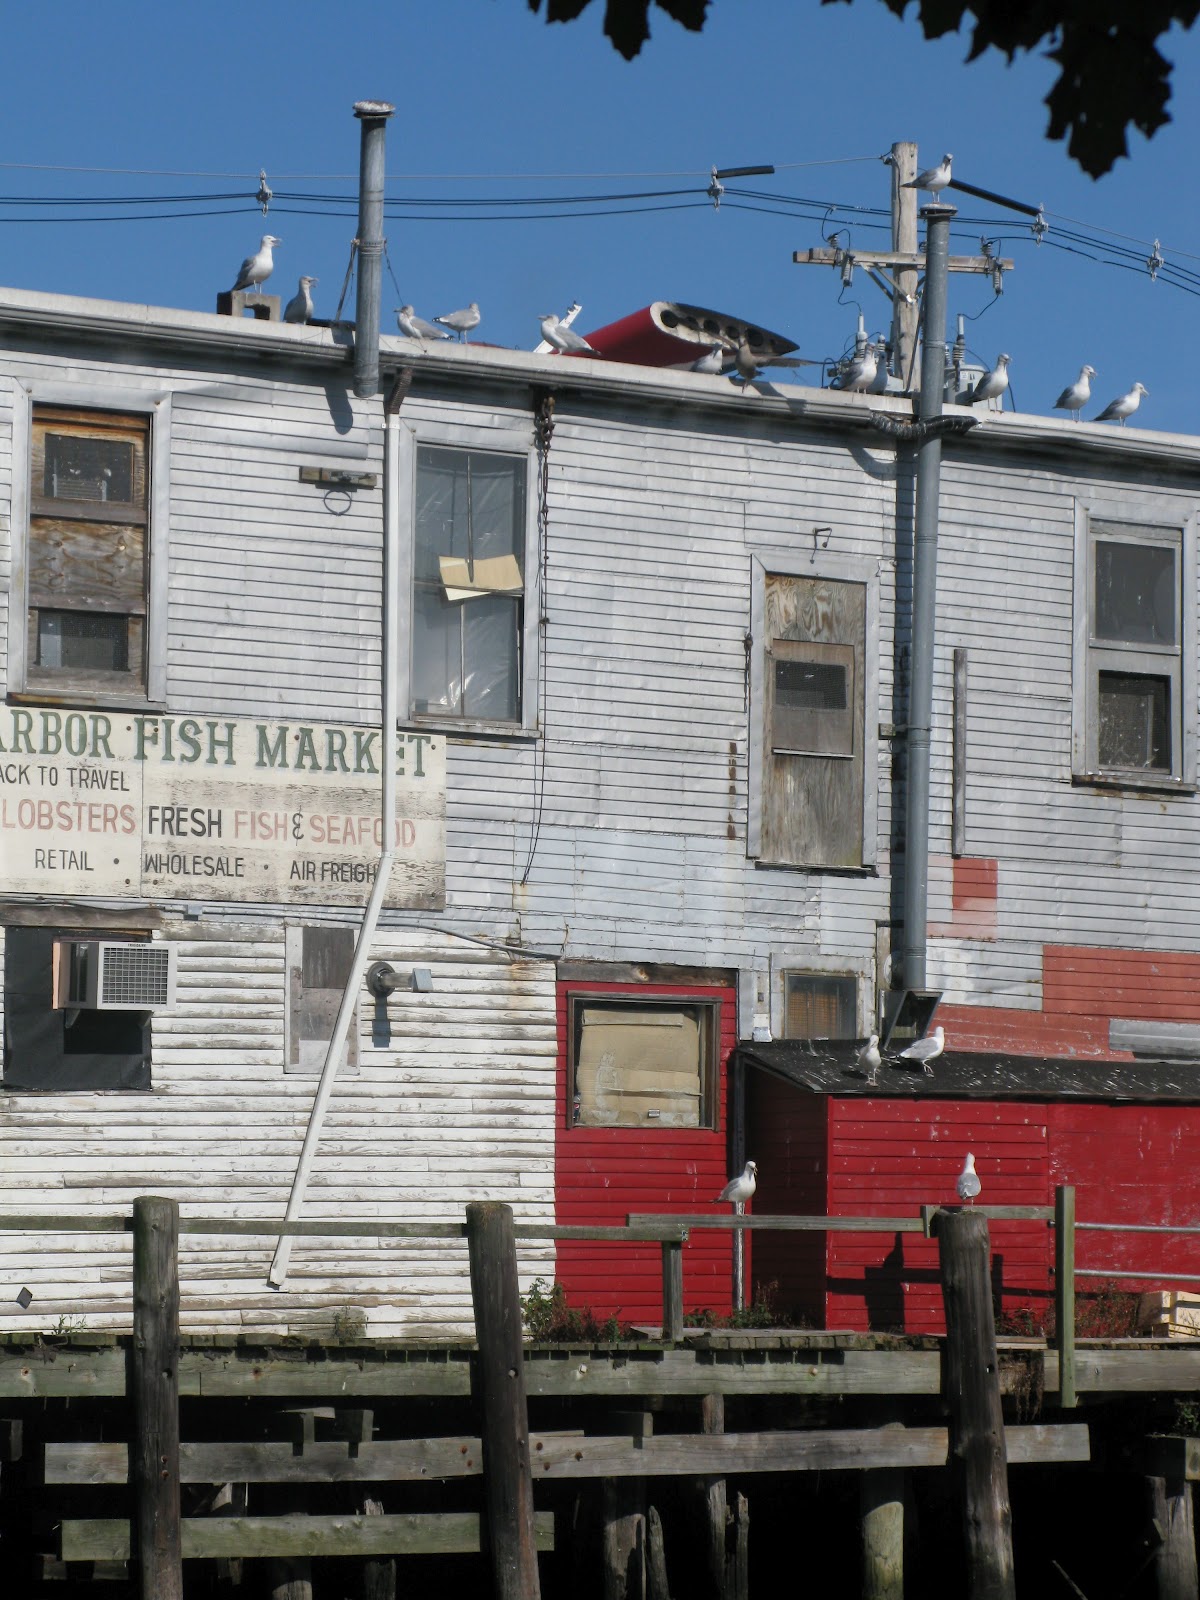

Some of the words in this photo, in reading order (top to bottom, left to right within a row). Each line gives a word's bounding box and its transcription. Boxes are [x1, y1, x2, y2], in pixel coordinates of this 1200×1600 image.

[133, 717, 237, 765] FISH
[37, 765, 58, 787] TO
[66, 767, 130, 792] TRAVEL
[2, 799, 136, 835] LOBSTERS
[148, 805, 222, 838] FRESH
[234, 810, 288, 841] FISH
[35, 848, 94, 871] RETAIL
[144, 853, 244, 878] WHOLESALE
[290, 860, 316, 881] AIR
[321, 861, 378, 884] FREIGH
